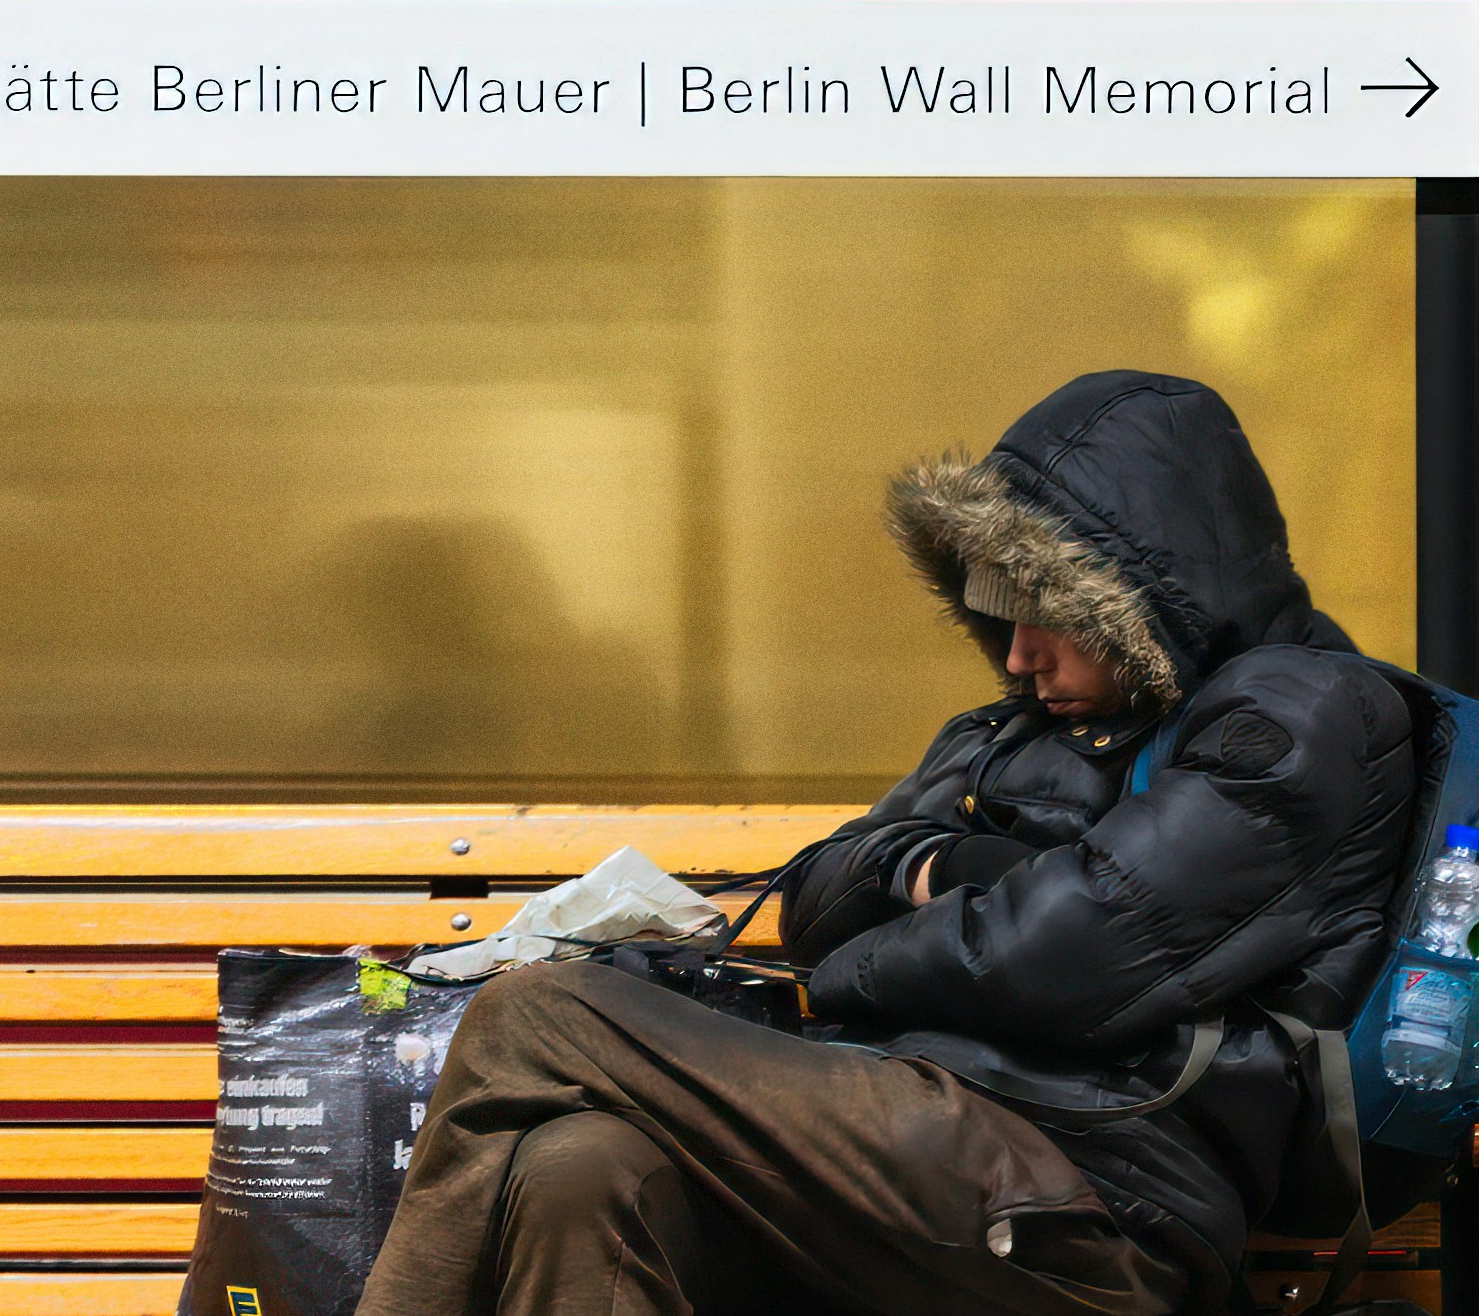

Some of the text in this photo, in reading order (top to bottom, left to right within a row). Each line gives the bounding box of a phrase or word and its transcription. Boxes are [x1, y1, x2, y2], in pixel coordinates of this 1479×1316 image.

[152, 63, 388, 114] Berliner
[417, 64, 611, 115] Mauer
[681, 65, 850, 115] Berlin
[879, 64, 1010, 115] Wall
[1044, 65, 1330, 115] Memorial
